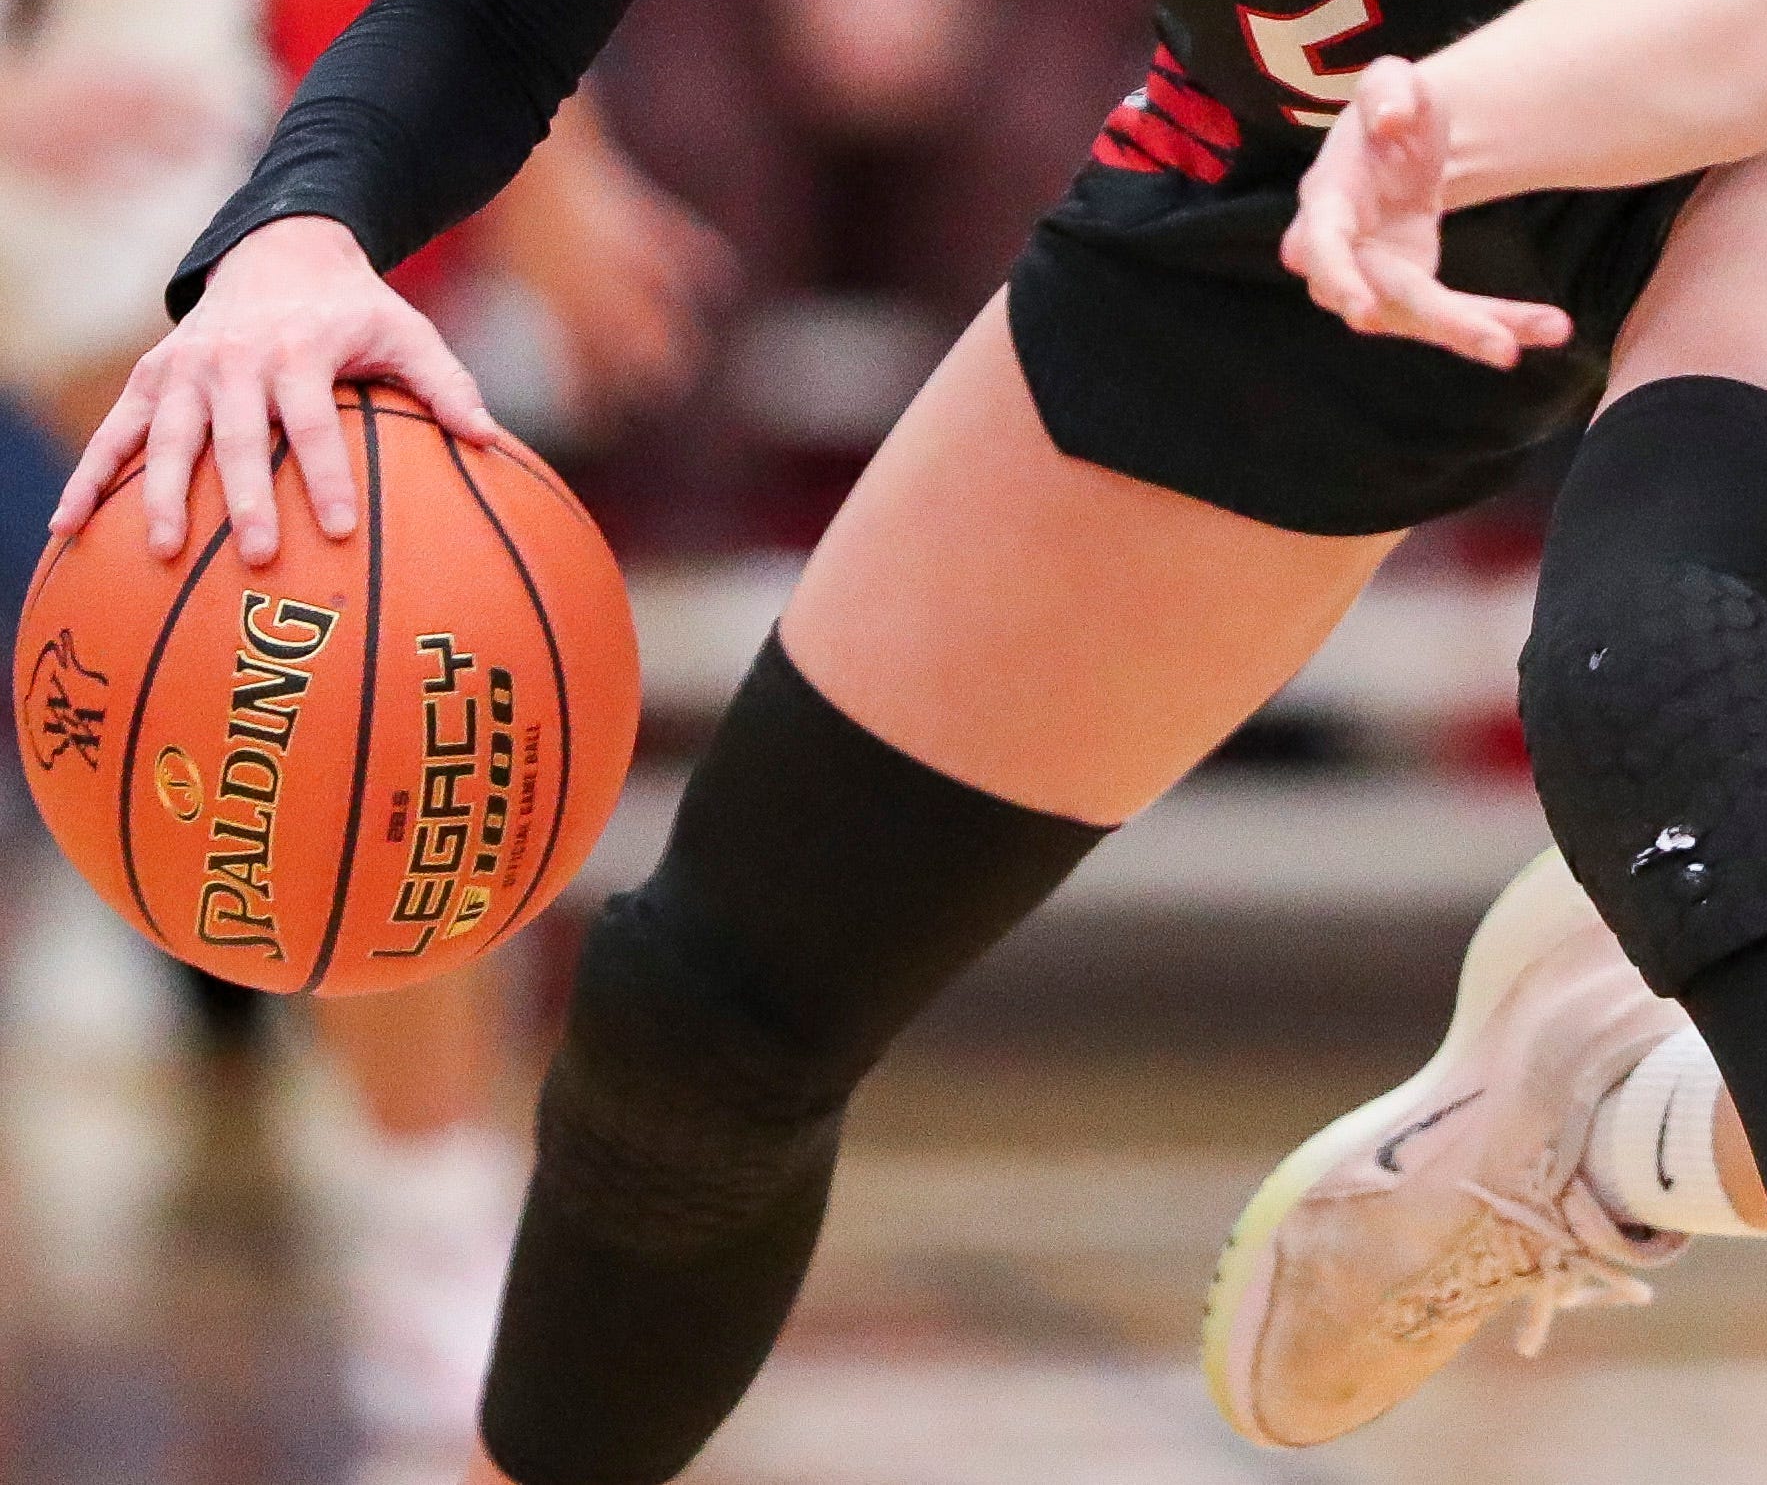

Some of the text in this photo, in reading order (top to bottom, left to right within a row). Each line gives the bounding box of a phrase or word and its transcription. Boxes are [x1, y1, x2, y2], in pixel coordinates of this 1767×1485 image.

[196, 589, 341, 962] SPALDING
[371, 632, 477, 957] LEGACY
[473, 665, 515, 876] 1000
[525, 722, 541, 764] BALL
